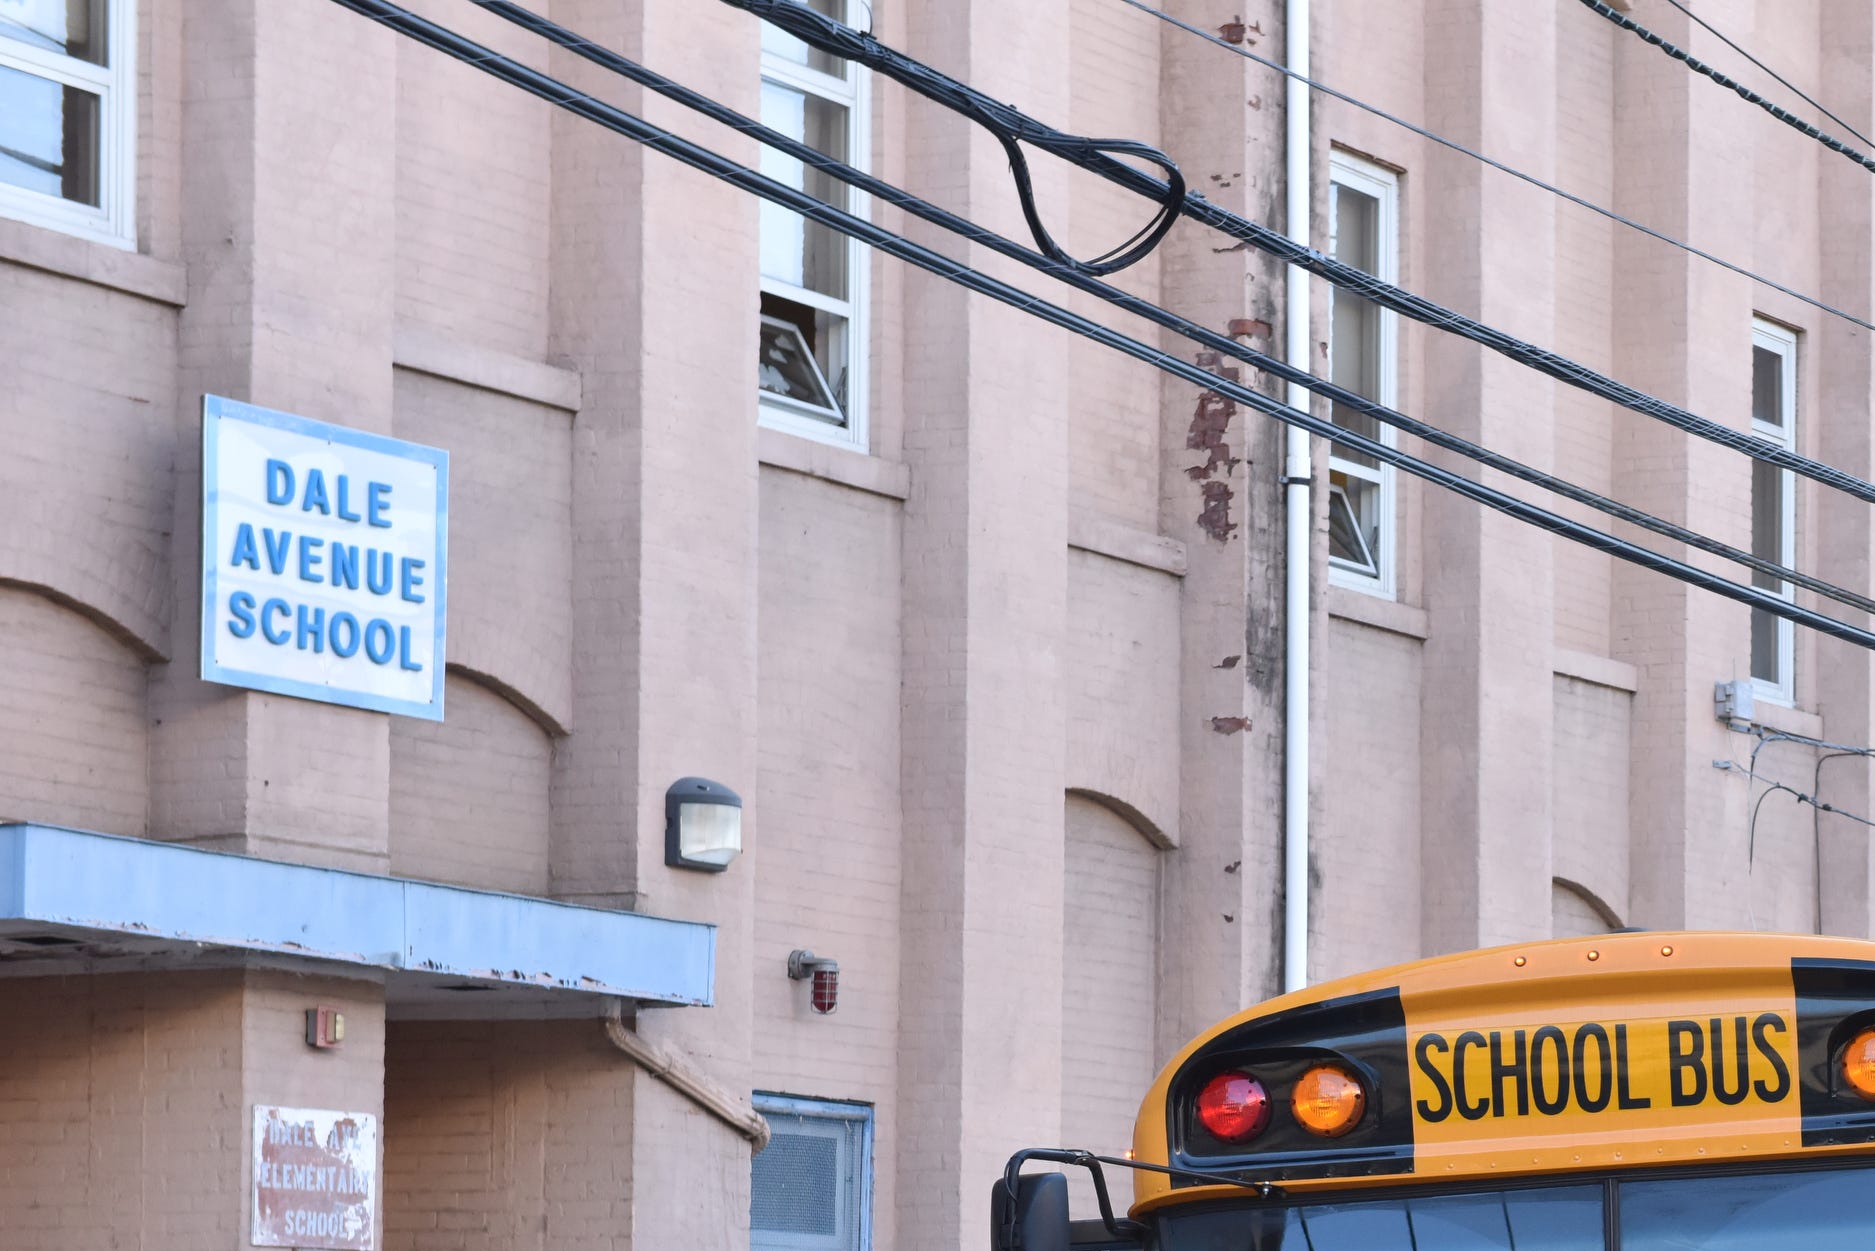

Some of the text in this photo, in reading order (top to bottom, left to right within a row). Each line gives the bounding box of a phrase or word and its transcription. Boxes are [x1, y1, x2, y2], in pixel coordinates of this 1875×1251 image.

[266, 459, 393, 528] DALE
[231, 522, 426, 604] AVENUE
[227, 591, 423, 672] SCHOOL
[1415, 1012, 1792, 1124] SCHOOL BUS
[259, 1162, 371, 1195] ELEMENTARY
[284, 1209, 349, 1239] SCHOOL
